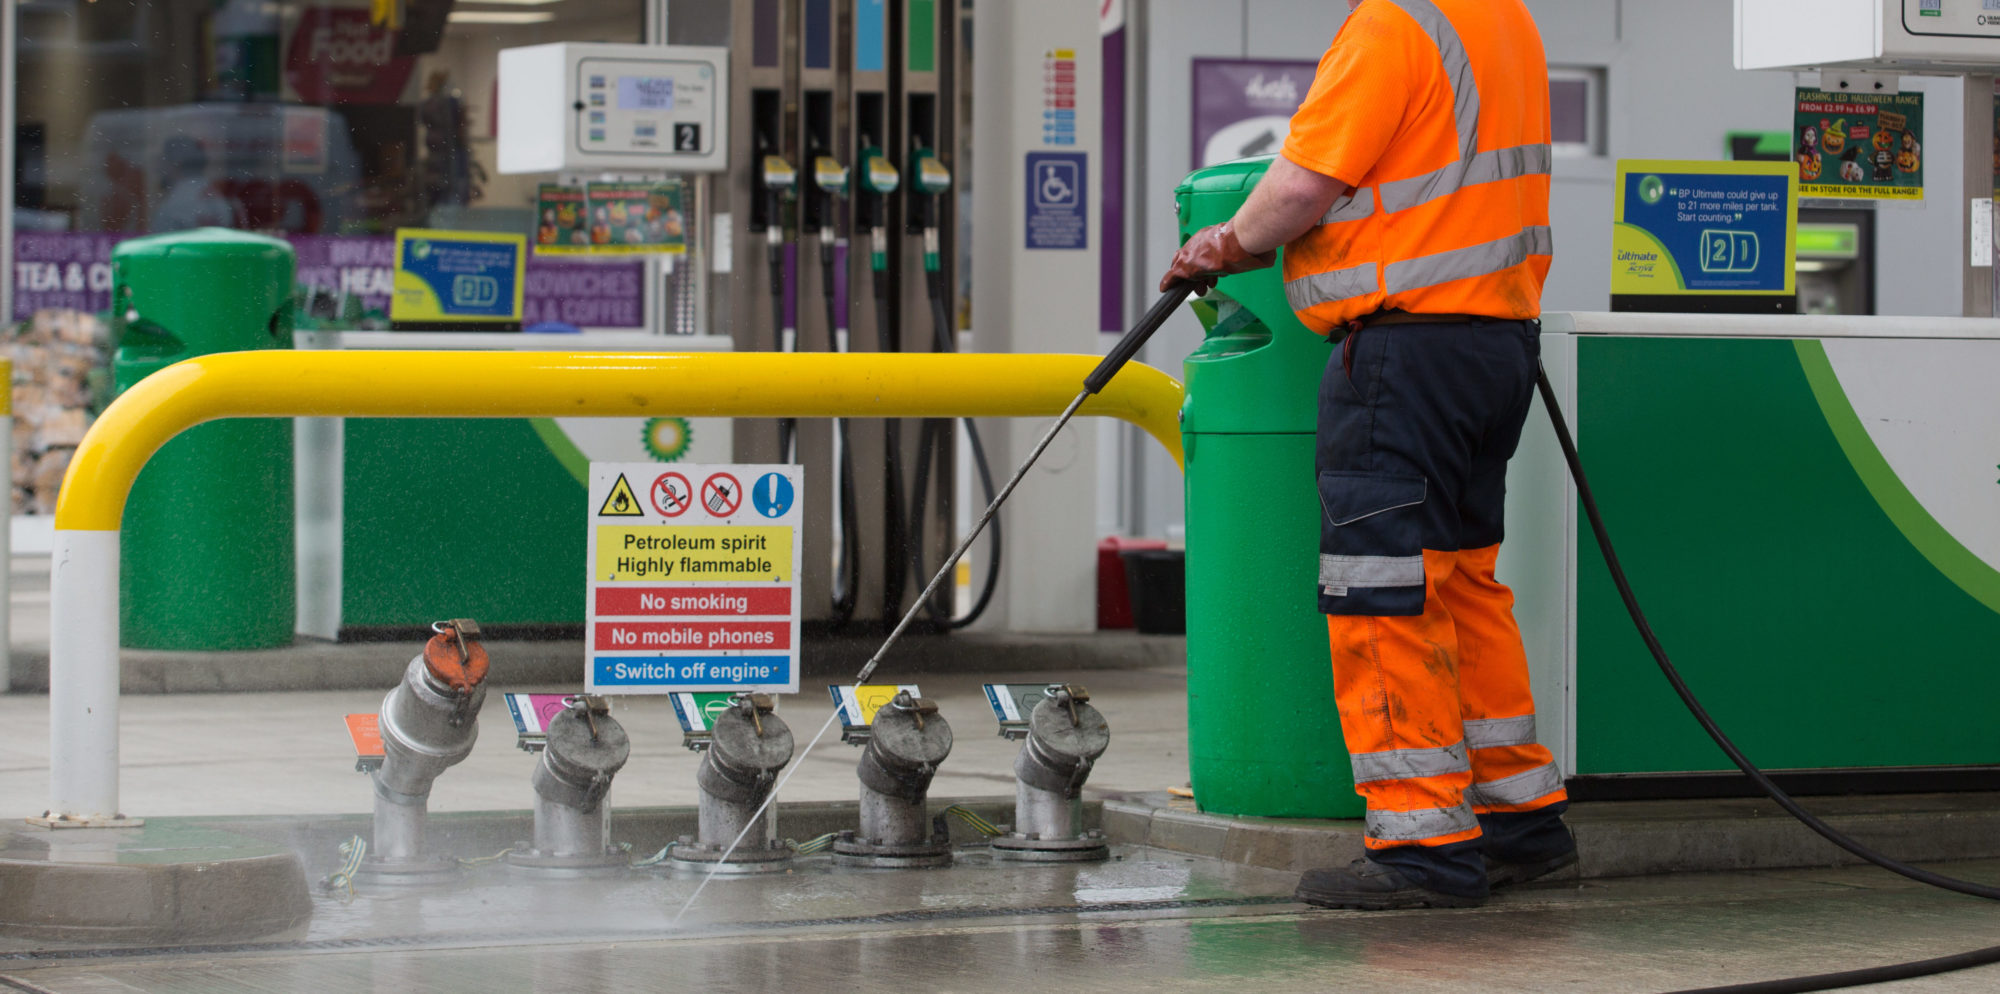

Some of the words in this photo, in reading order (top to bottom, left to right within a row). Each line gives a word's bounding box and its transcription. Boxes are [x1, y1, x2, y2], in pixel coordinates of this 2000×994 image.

[310, 28, 391, 64] Food
[1799, 92, 1831, 102] FLASHING
[1835, 94, 1848, 102] LED
[1851, 94, 1892, 104] HALLOWEEN
[1895, 95, 1919, 105] RANGE
[1801, 103, 1822, 111] FROM
[1824, 104, 1844, 112] £2.99
[1855, 105, 1876, 113] £6.99
[681, 125, 694, 150] 2
[1692, 189, 1725, 199] Ultimate
[1726, 190, 1748, 200] could
[1749, 191, 1766, 201] give
[1767, 192, 1778, 201] up
[1810, 185, 1818, 193] IN
[1677, 201, 1686, 210] to
[1687, 201, 1697, 210] 21
[1700, 202, 1720, 210] more
[1722, 202, 1744, 211] miles
[1745, 203, 1759, 212] per
[1760, 202, 1779, 211] tank.
[1677, 211, 1696, 222] Start
[1617, 251, 1657, 261] ultimate
[17, 262, 61, 291] TEA
[64, 262, 85, 291] &
[562, 299, 636, 324] COFFEE
[624, 534, 715, 550] Petroleum
[721, 535, 766, 553] spirit
[617, 557, 674, 576] Highly
[680, 557, 772, 573] flammable
[640, 594, 666, 610] No
[671, 594, 748, 613] smoking
[612, 628, 637, 644] No
[642, 628, 703, 644] mobile
[708, 628, 775, 647] phones
[614, 663, 675, 679] Switch
[681, 662, 706, 679] off
[710, 662, 770, 682] engine
